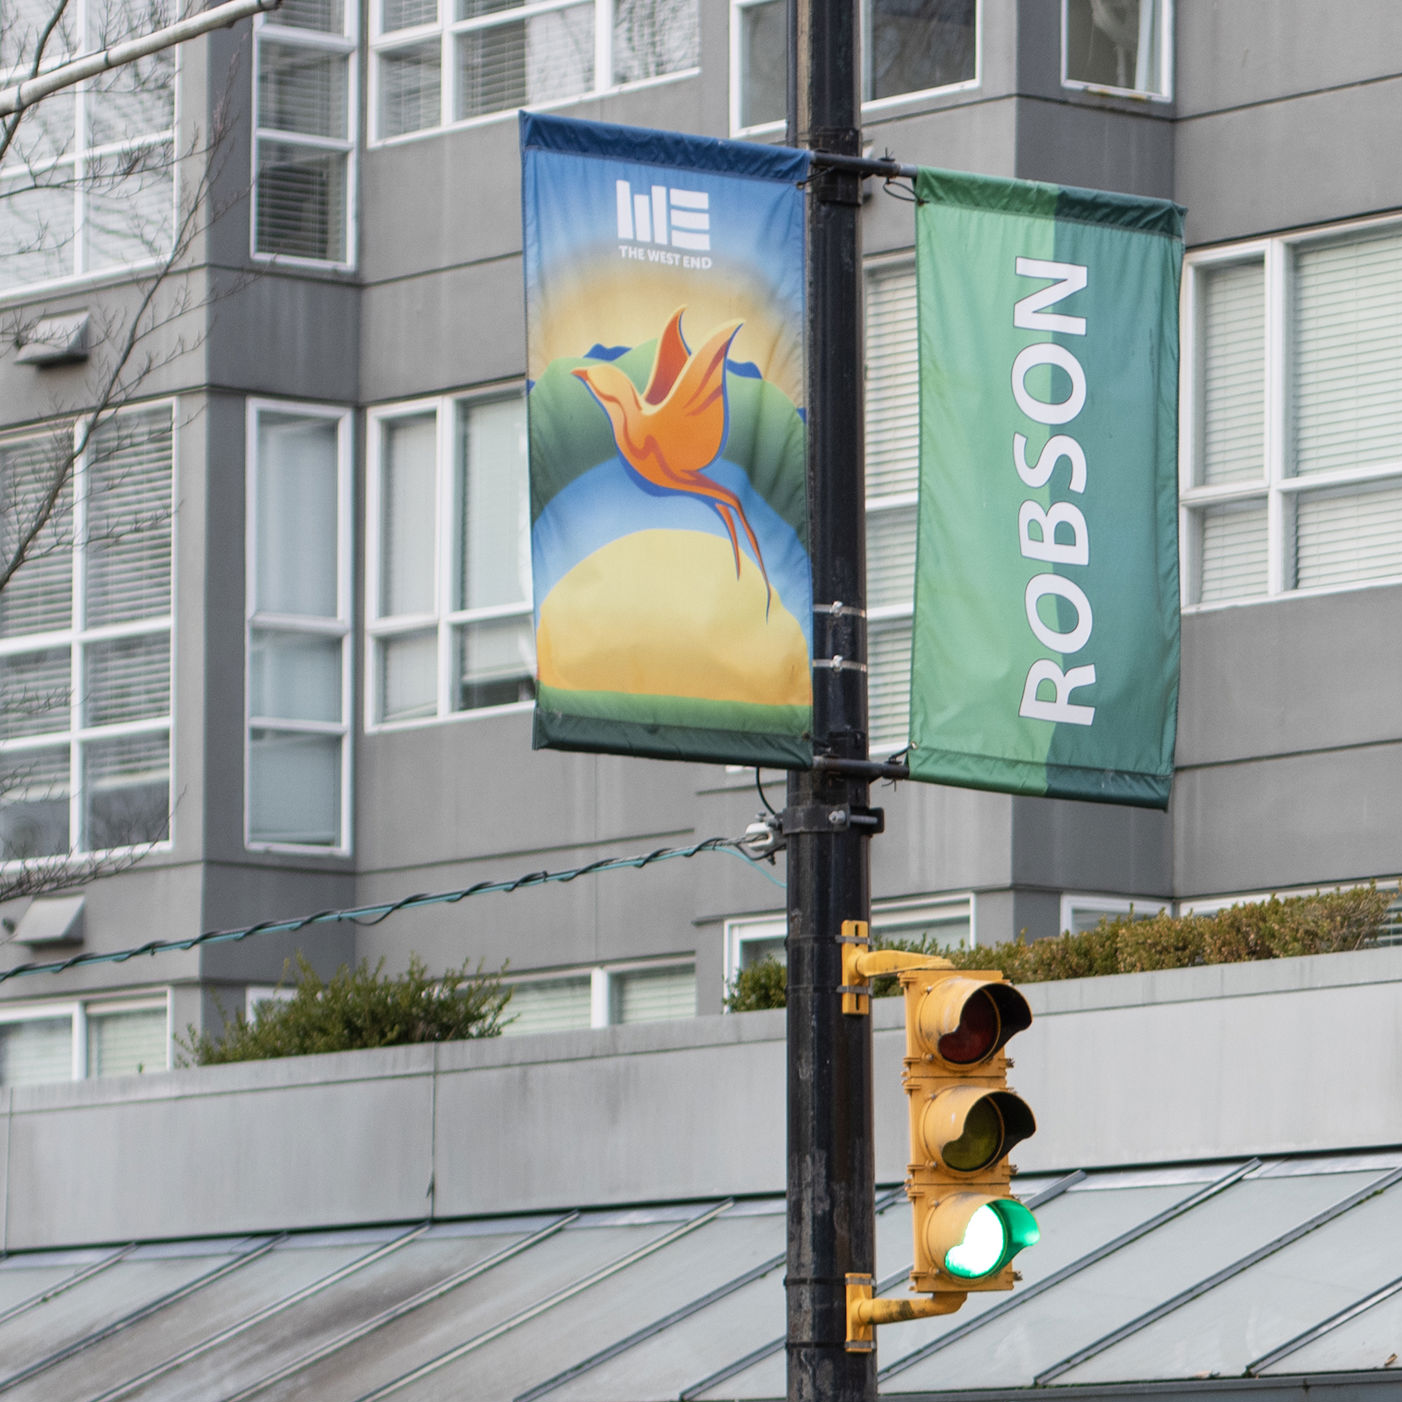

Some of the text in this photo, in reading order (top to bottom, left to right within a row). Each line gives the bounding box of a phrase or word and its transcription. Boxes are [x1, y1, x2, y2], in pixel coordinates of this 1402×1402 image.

[619, 245, 712, 270] THE WEST END
[1010, 256, 1097, 727] ROBSON
